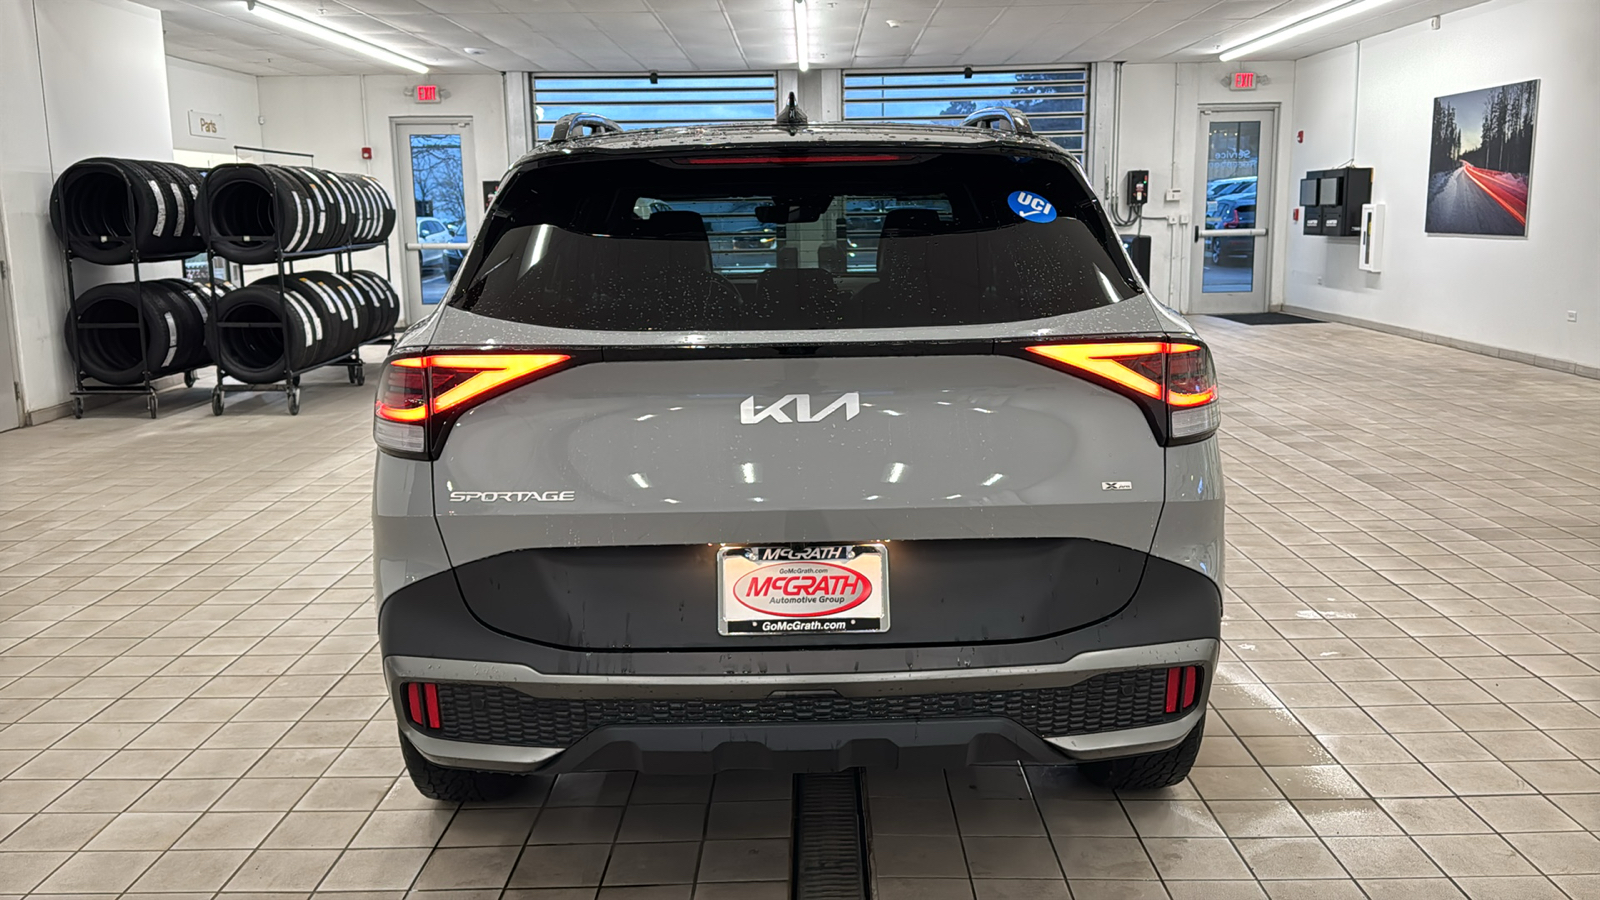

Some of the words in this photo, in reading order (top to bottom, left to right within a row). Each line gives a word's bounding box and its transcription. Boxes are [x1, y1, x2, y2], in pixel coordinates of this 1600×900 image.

[1235, 72, 1254, 88] EXIT
[417, 85, 437, 101] EXIT
[1017, 191, 1053, 215] UCI
[740, 392, 860, 424] KIA
[449, 490, 575, 502] SPORTAGE
[769, 596, 817, 604] Automotive
[818, 596, 845, 605] Group
[762, 620, 846, 631] GoMcGrath.com
